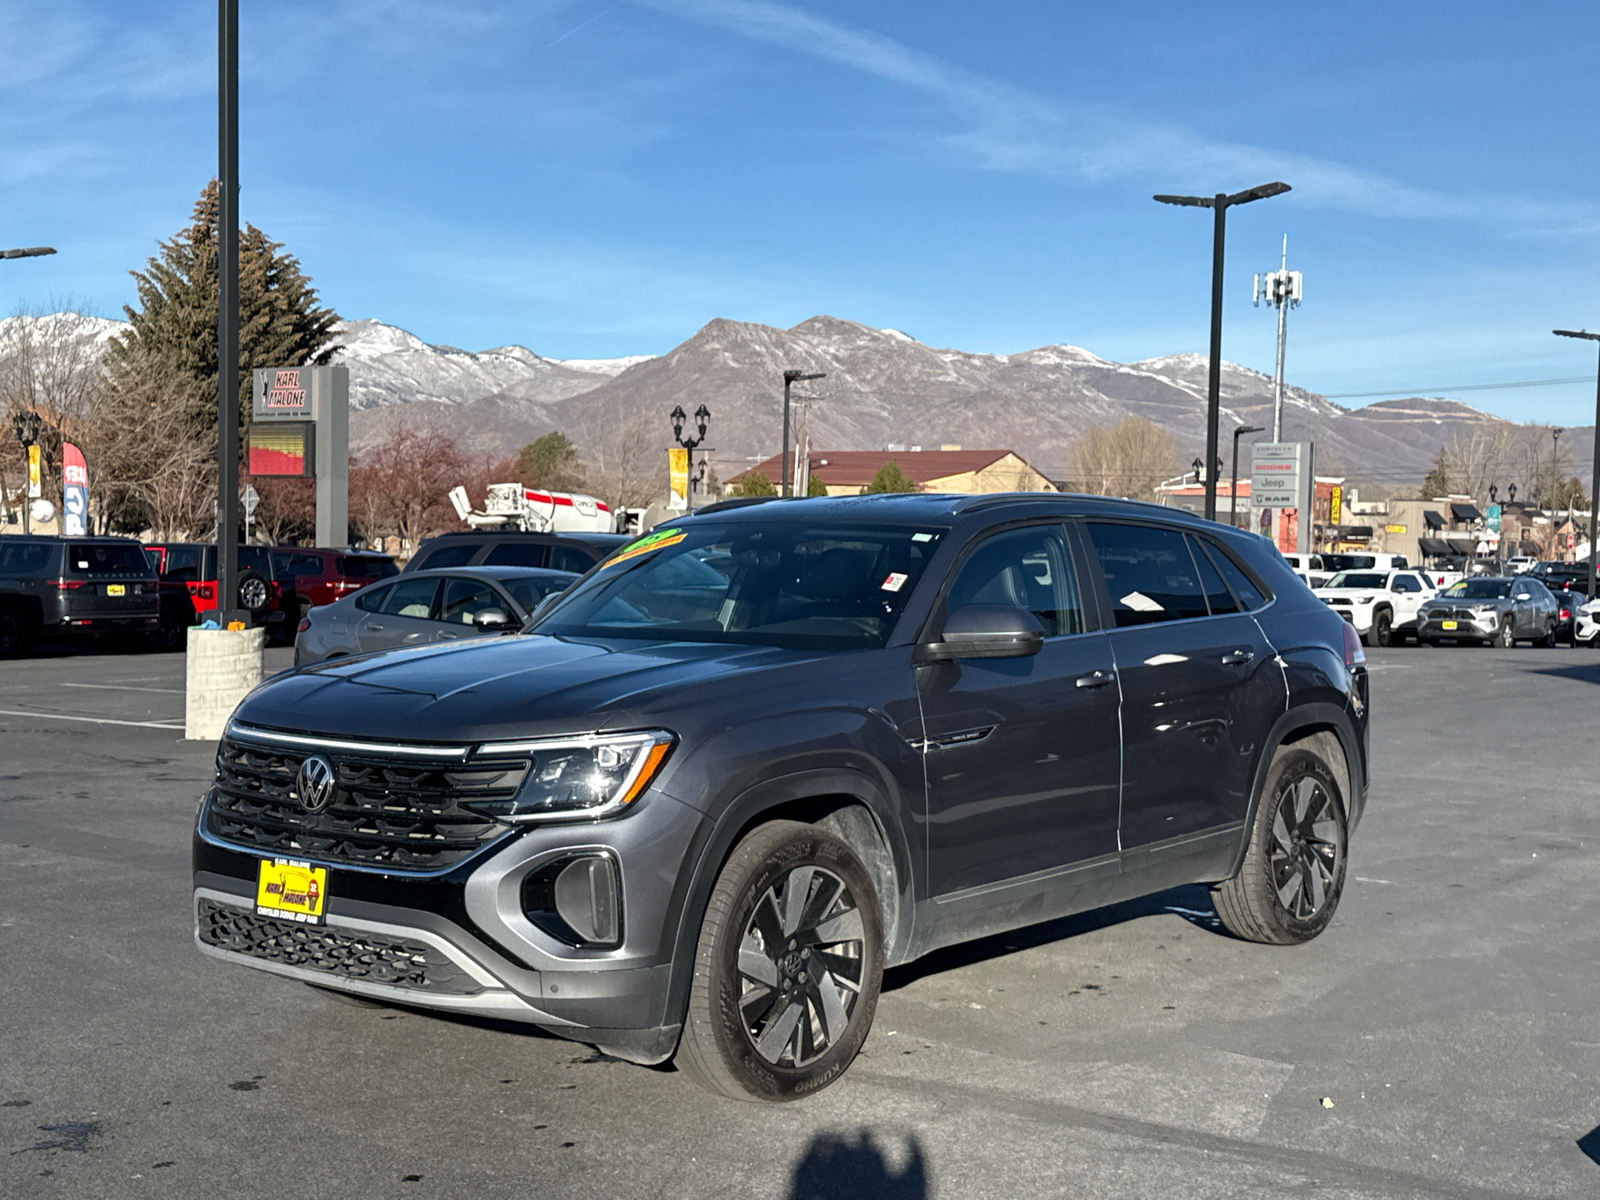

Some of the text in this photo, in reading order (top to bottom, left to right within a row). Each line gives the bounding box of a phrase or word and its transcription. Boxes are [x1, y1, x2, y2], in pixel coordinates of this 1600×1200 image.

[275, 371, 299, 388] KARL
[268, 389, 306, 407] MALONE
[1261, 478, 1285, 488] Jeep
[794, 1062, 840, 1093] KUMHO
